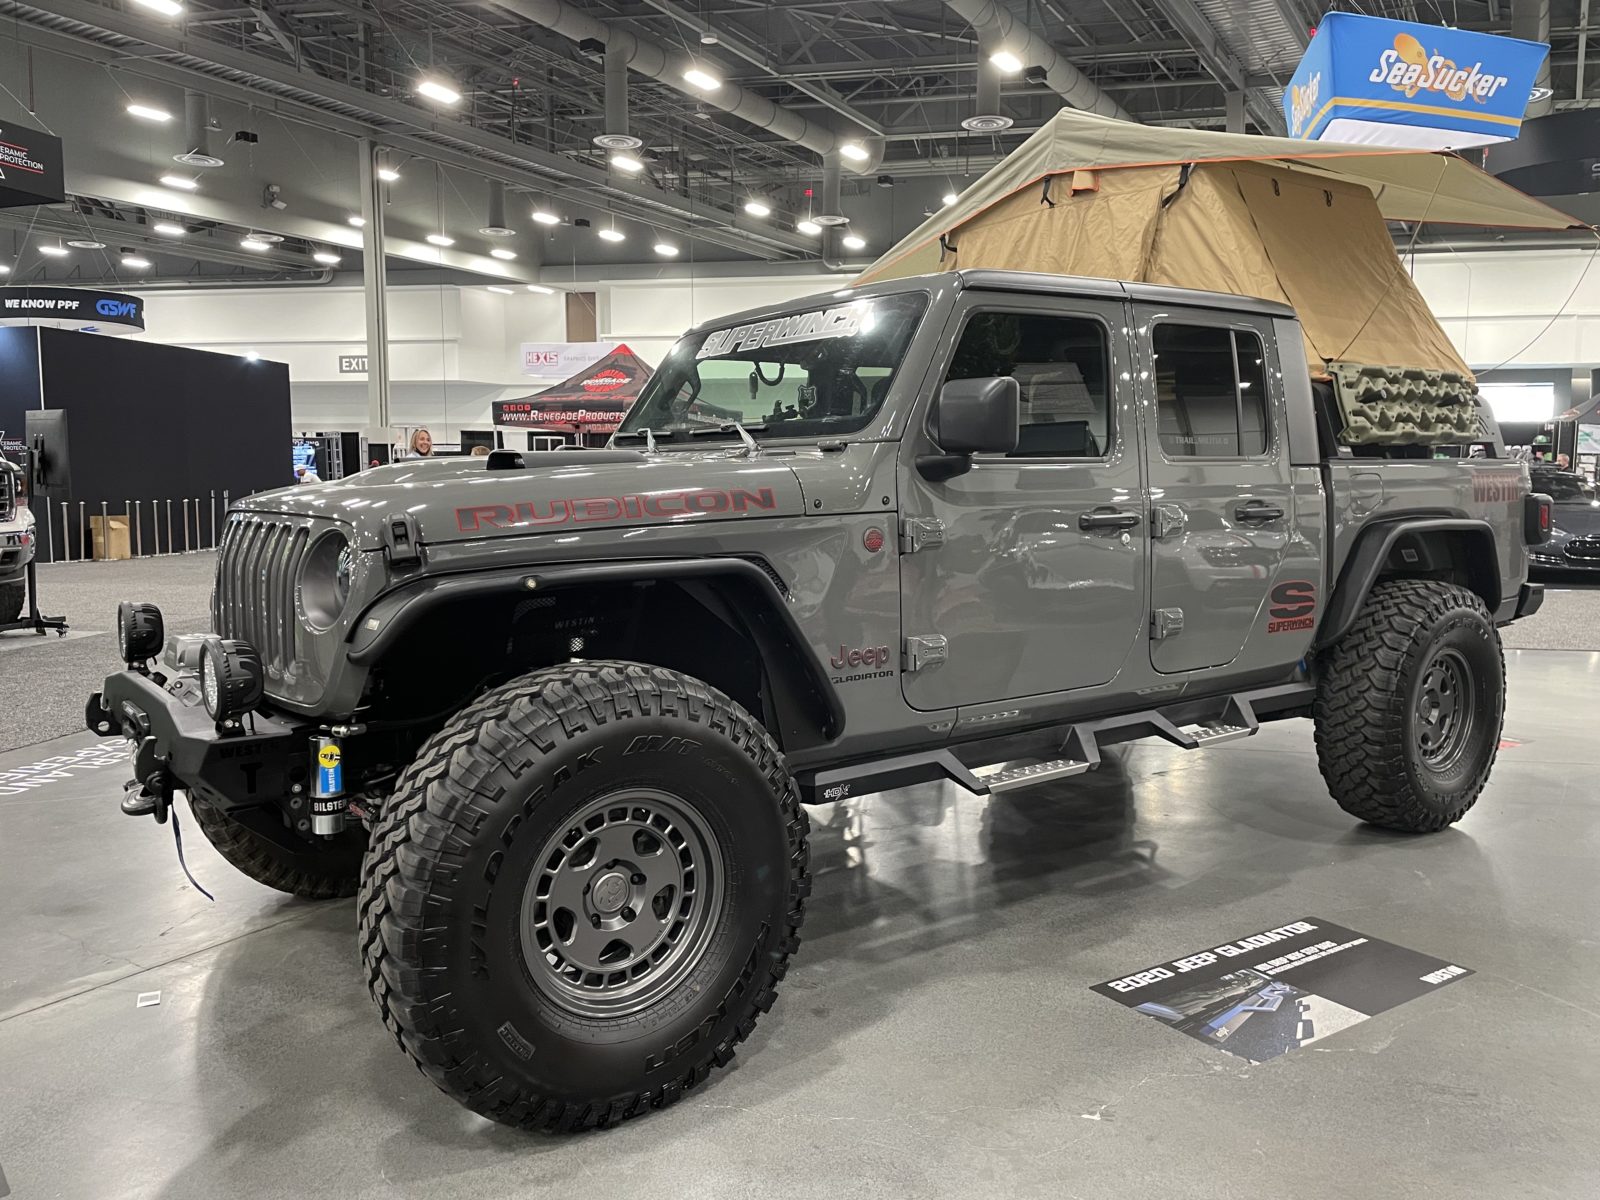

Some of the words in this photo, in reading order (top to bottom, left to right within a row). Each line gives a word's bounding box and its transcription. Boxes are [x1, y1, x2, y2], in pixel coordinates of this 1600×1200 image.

[1369, 49, 1508, 98] SeaSucker
[0, 145, 28, 160] ERAMIC
[0, 153, 43, 171] PROTECTION
[5, 299, 20, 308] WE
[21, 299, 55, 310] KNOW
[58, 300, 80, 310] PPF
[342, 358, 368, 371] EXIT
[526, 352, 558, 367] HEXIS
[1472, 474, 1520, 503] WESTIN
[455, 488, 776, 532] RUBICON
[1267, 617, 1315, 634] SUPERWINCH
[831, 645, 890, 669] Jeep
[832, 670, 894, 684] GLADIATOR
[1107, 967, 1176, 993] 2020
[1171, 952, 1218, 973] JEEP
[1213, 921, 1319, 957] GLADIATOR
